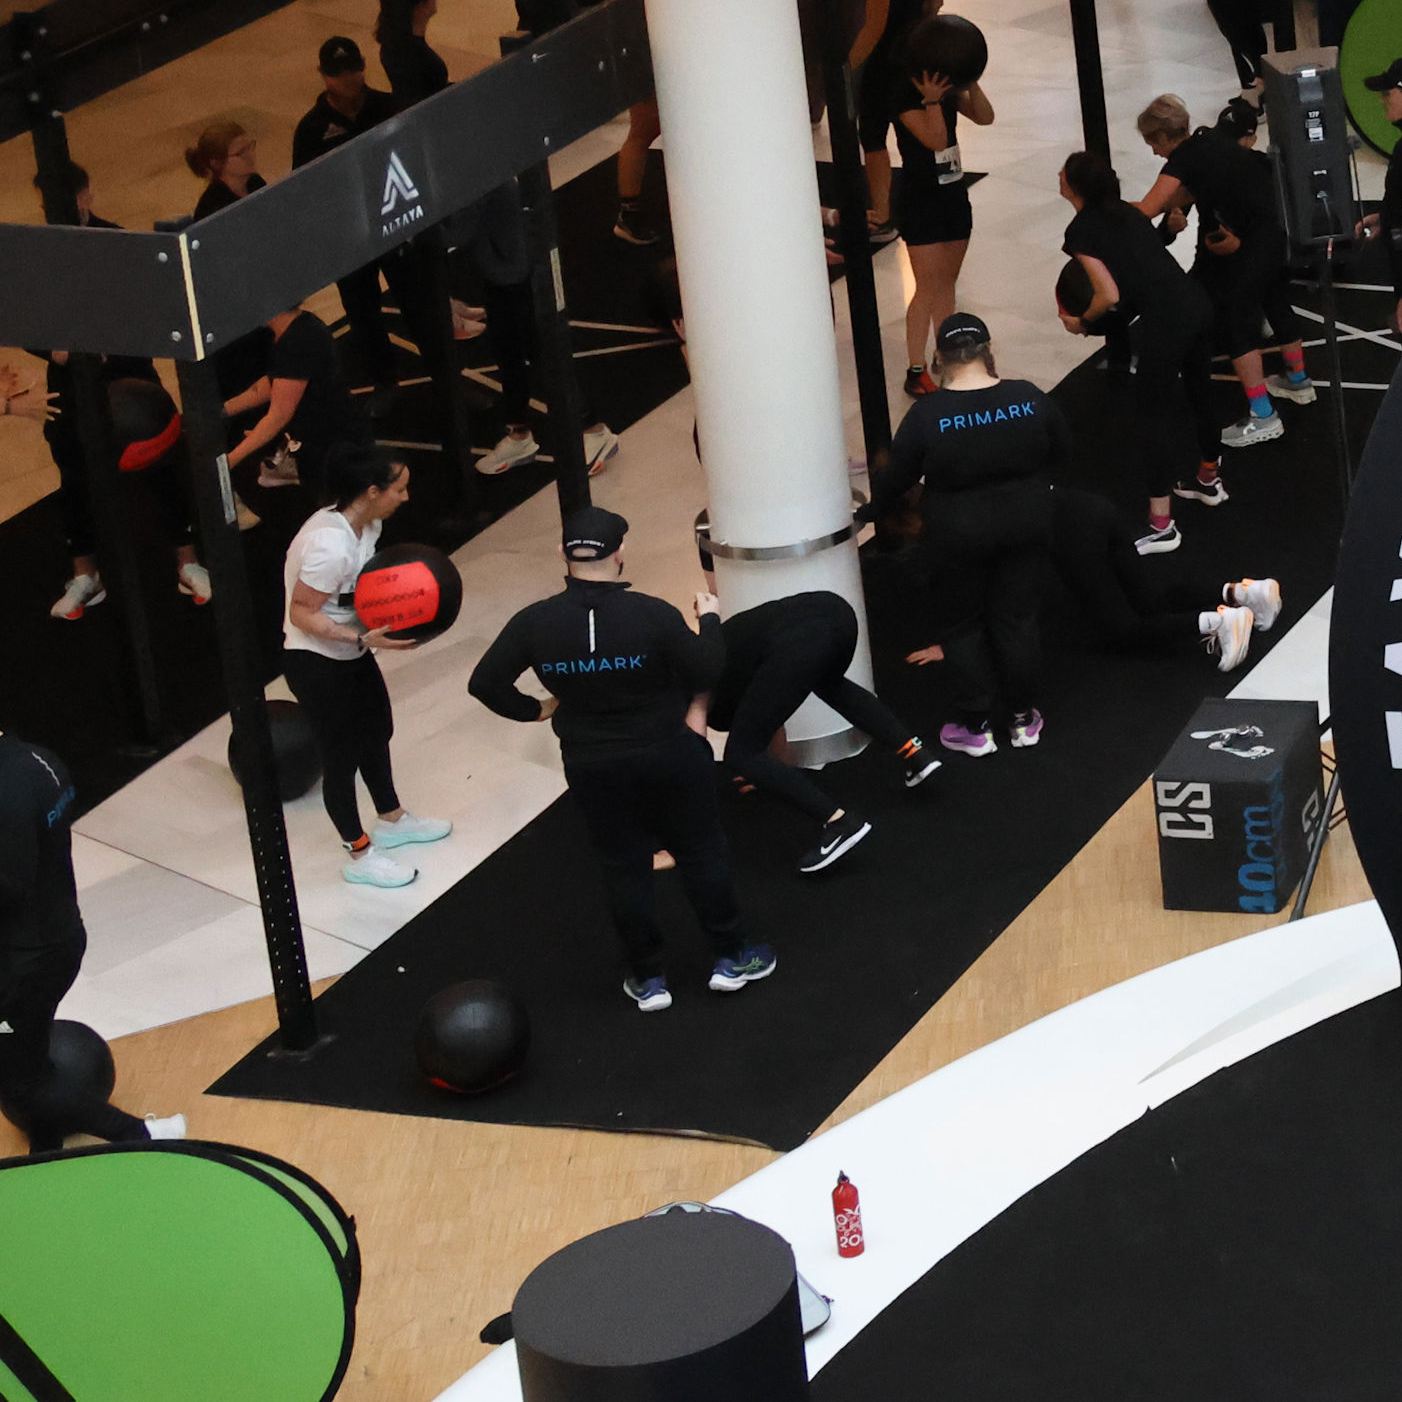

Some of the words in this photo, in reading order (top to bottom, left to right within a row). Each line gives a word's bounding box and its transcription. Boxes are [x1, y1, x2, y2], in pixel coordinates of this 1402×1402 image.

[382, 205, 424, 237] ALTAYA
[939, 402, 1035, 433] PRIMARK
[542, 654, 644, 675] PRIMARK
